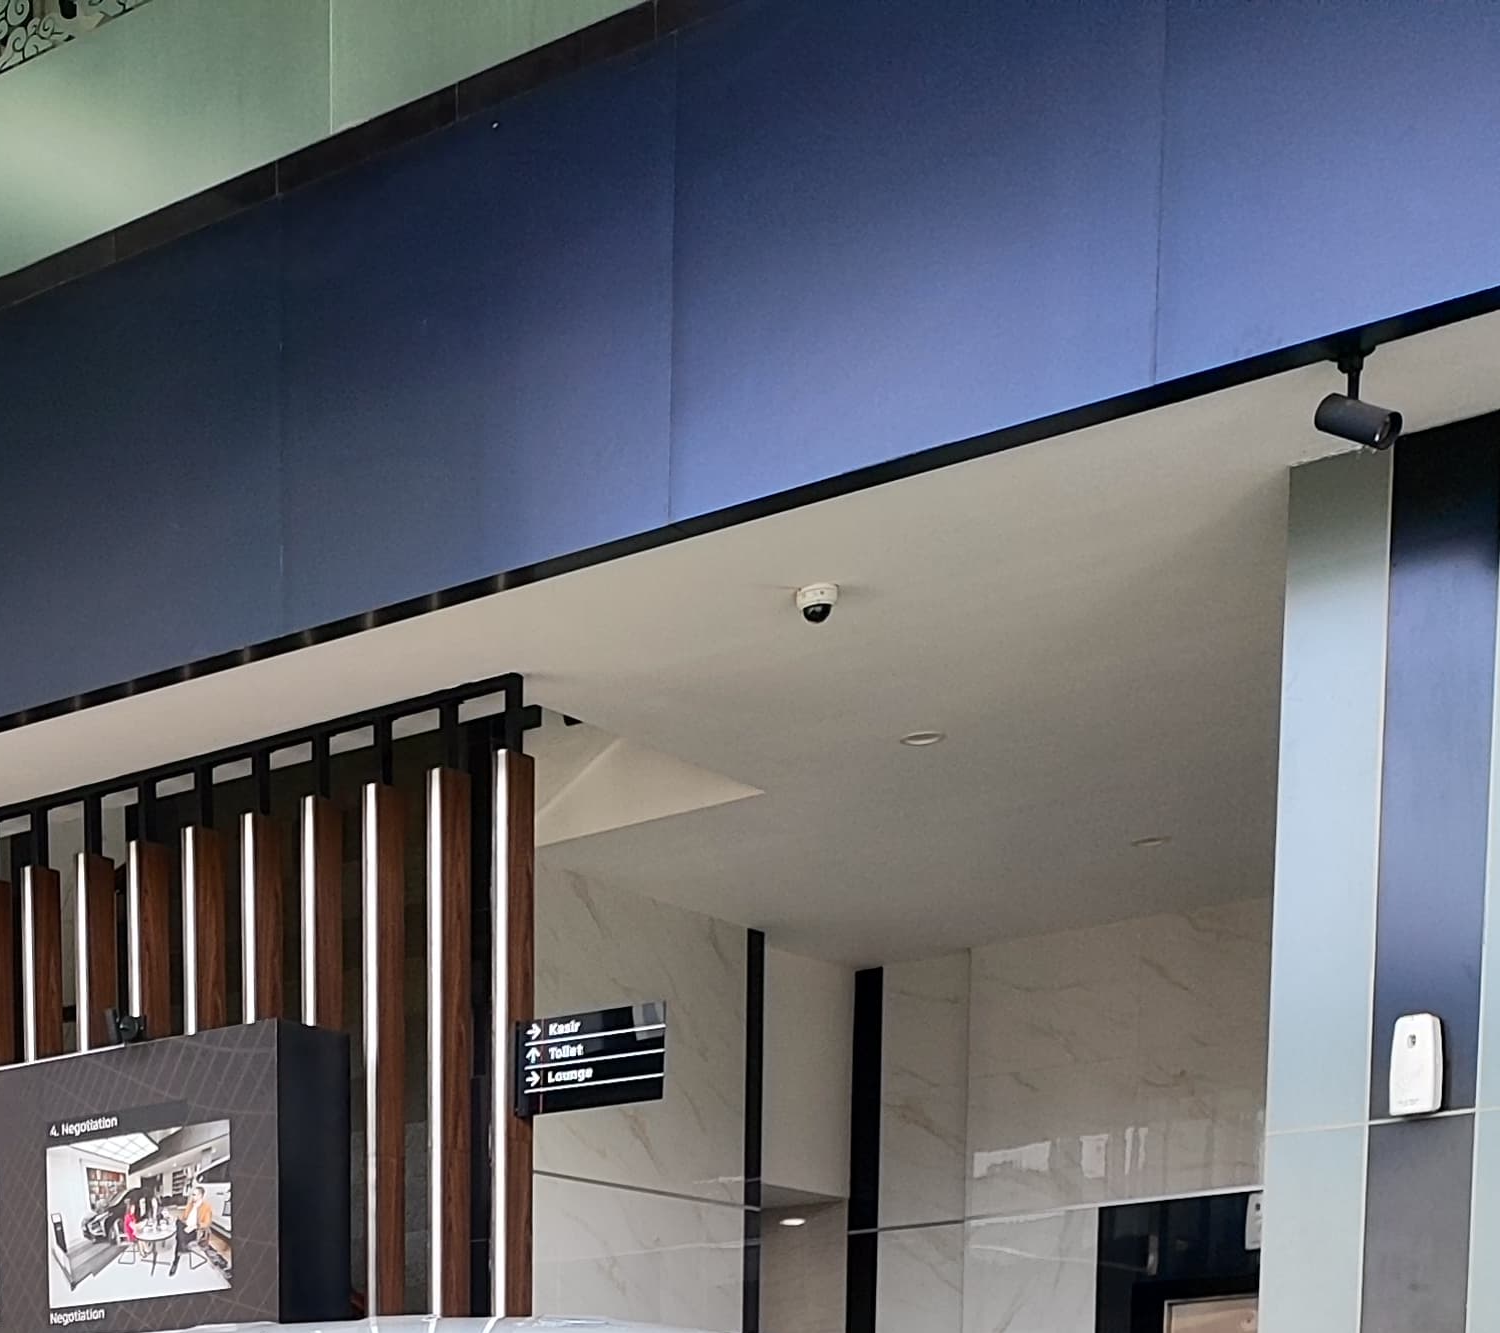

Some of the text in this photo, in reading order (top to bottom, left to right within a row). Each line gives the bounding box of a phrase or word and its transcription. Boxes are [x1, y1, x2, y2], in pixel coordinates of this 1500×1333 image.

[548, 1019, 581, 1036] Kasir
[548, 1043, 584, 1060] Toilet
[547, 1067, 594, 1083] Lounge
[49, 1116, 118, 1137] 4. Negotiation
[49, 1308, 105, 1326] Negotiation
